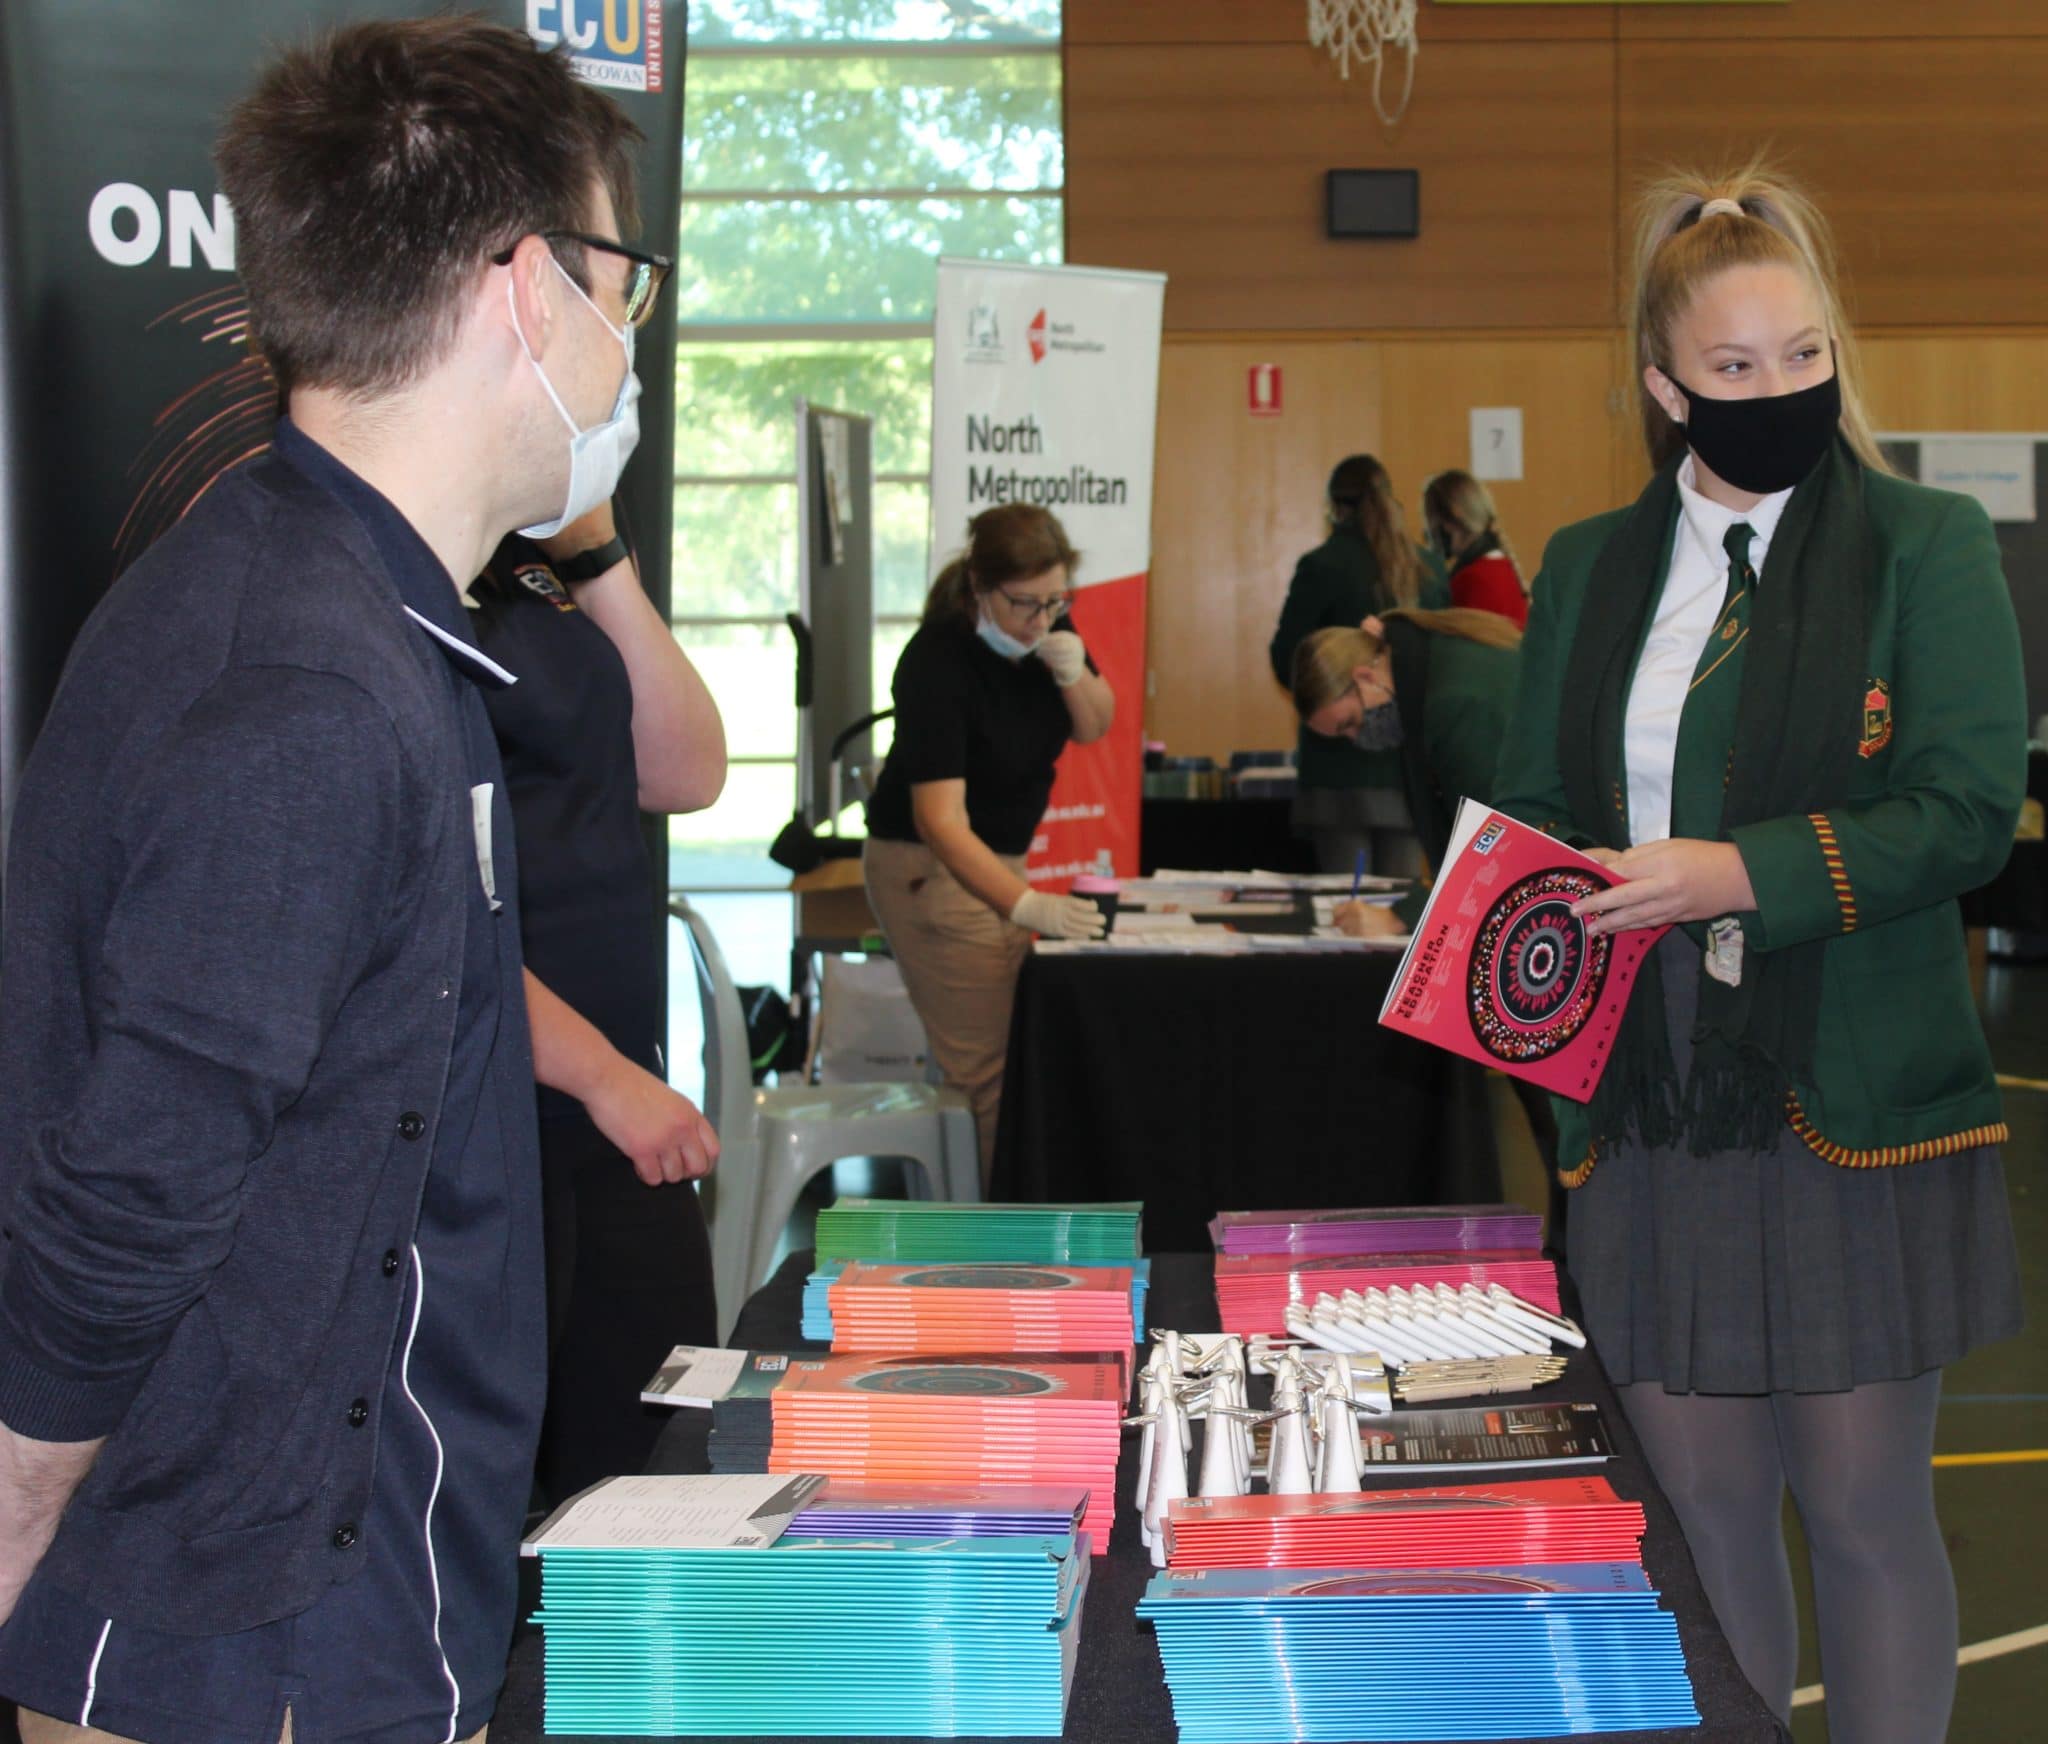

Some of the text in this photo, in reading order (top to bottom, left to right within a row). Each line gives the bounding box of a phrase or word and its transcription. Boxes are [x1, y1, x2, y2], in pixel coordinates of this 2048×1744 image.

[526, 0, 640, 55] ECU
[967, 414, 1042, 453] North
[1489, 427, 1504, 449] 7
[968, 464, 1127, 505] Metropolitan
[1474, 822, 1501, 852] ECU
[1396, 940, 1436, 1015] TEACHER
[1403, 923, 1449, 1019] EDUCATION
[1580, 1004, 1617, 1089] WORLD
